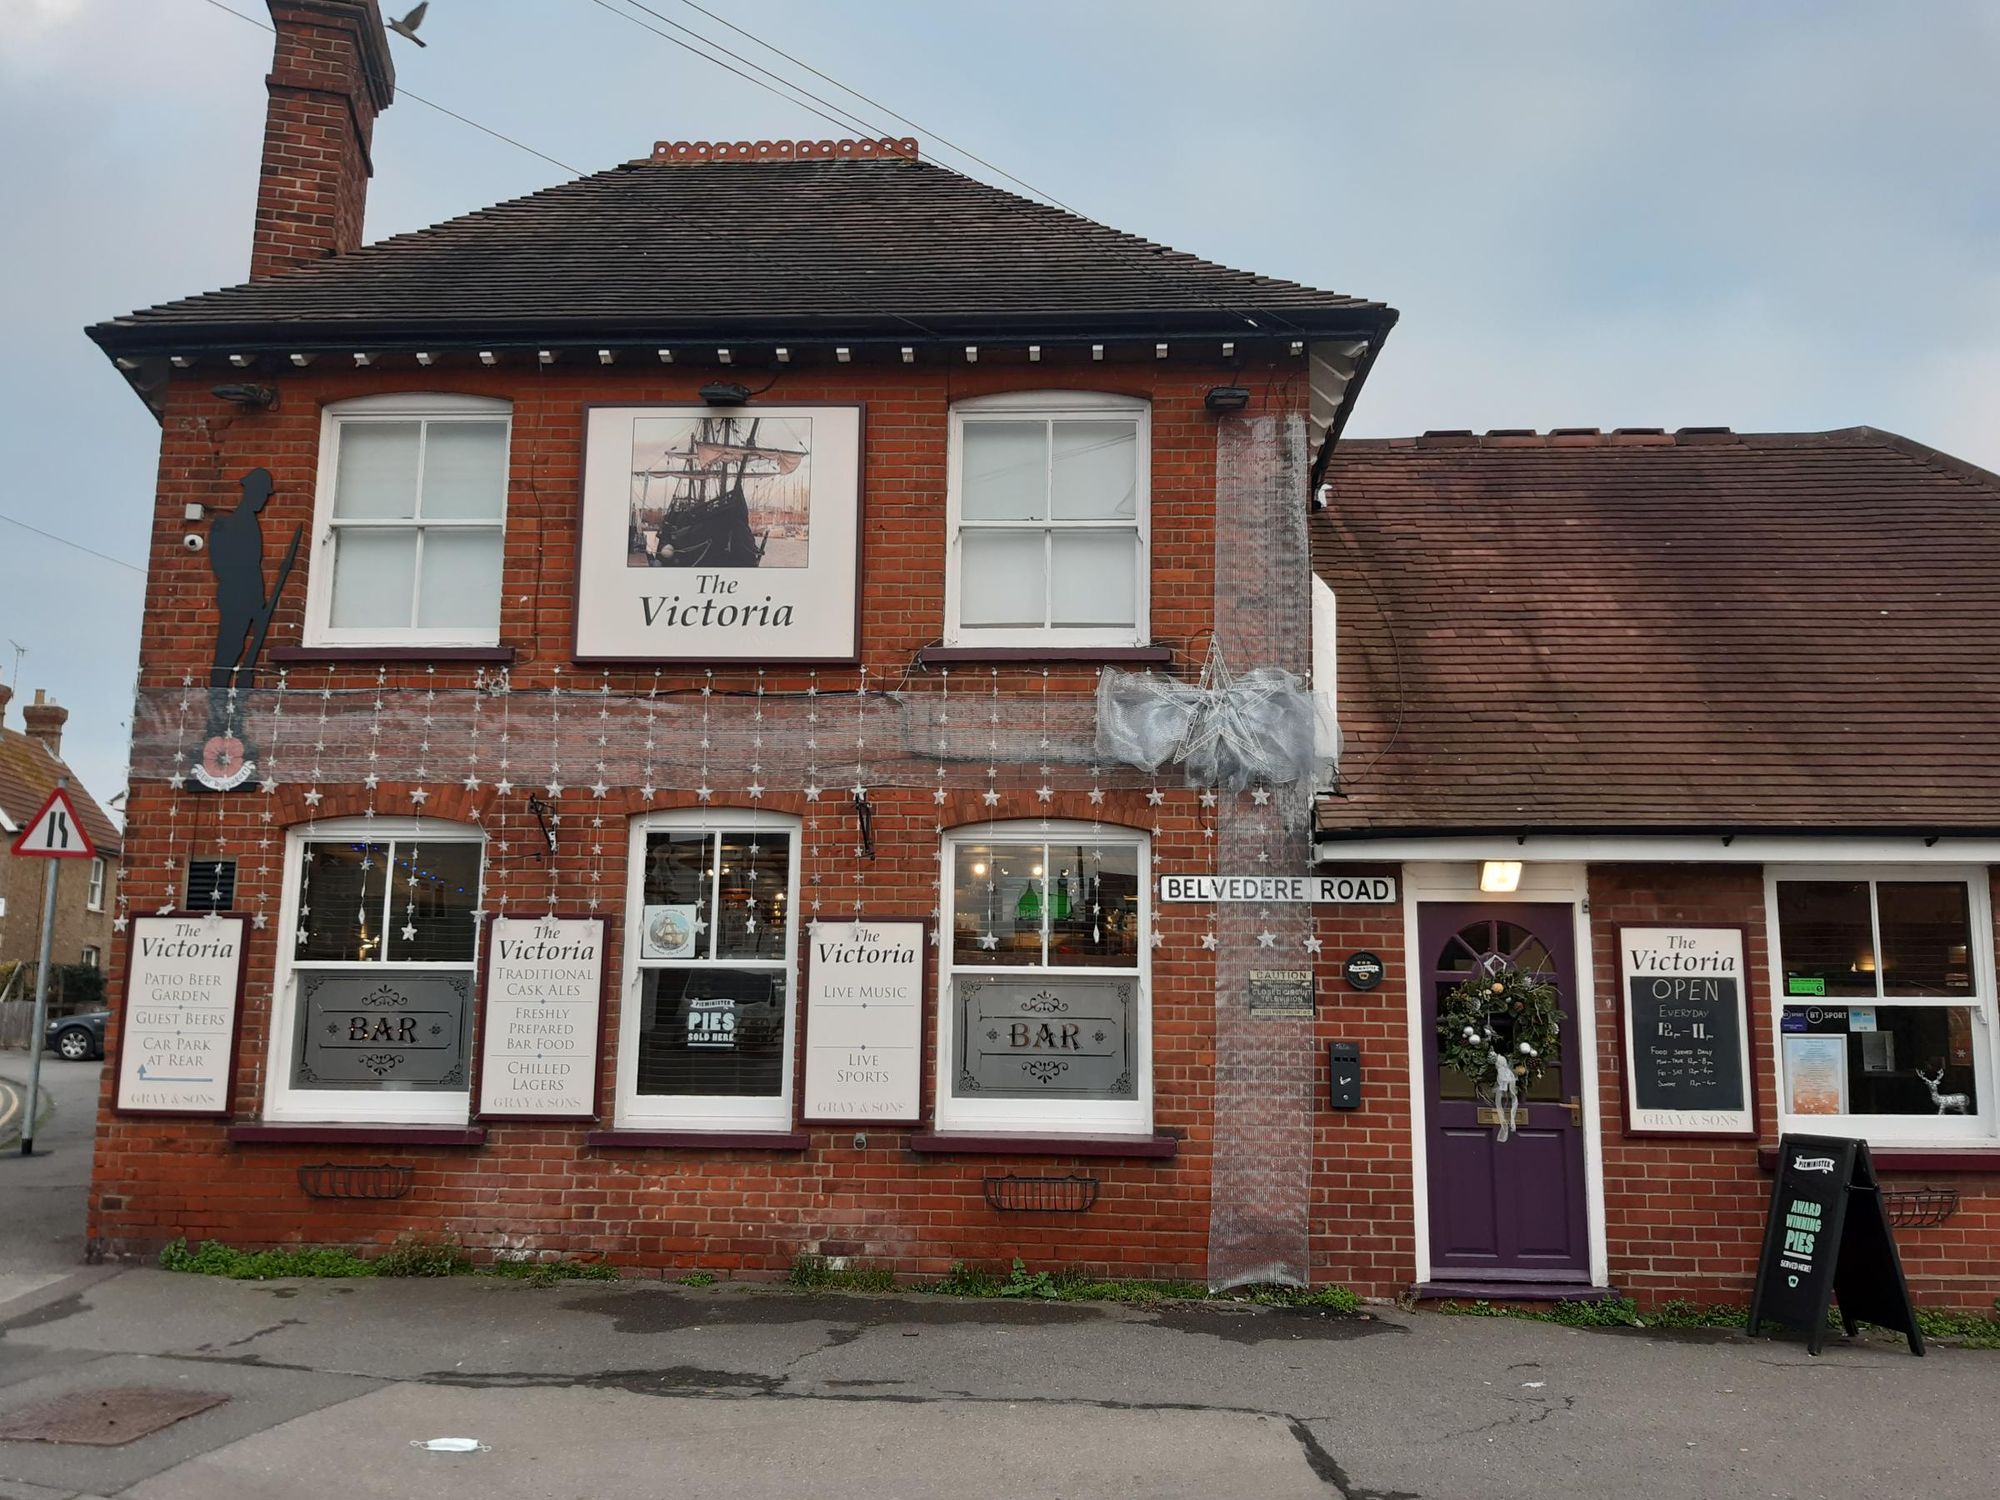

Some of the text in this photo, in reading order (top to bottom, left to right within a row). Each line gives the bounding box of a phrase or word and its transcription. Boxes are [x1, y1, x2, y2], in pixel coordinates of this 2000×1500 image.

[696, 574, 738, 594] The
[640, 596, 794, 627] Victoria
[1168, 878, 1389, 901] BELVEDERE ROAD
[175, 924, 200, 937] The
[534, 926, 560, 939] The
[854, 929, 880, 942] The
[141, 937, 233, 958] Victoria
[1667, 935, 1696, 949] The
[499, 940, 595, 961] Victoria
[818, 943, 915, 964] Victoria
[1630, 950, 1735, 971] Victoria
[144, 972, 222, 986] PATIO BEER
[496, 967, 594, 980] TRADITIONAL
[1256, 971, 1307, 979] CAUTION
[151, 989, 210, 1001] GARDEN
[507, 983, 580, 996] CASK ALES
[824, 985, 908, 999] LIVE MUSIC
[1652, 979, 1719, 1001] OPEN
[516, 1007, 570, 1019] FRESHLY
[1659, 1004, 1710, 1018] EVERYDAY
[1809, 1011, 1820, 1019] BT
[136, 1011, 225, 1026] GUEST BEERS
[688, 1012, 735, 1030] PIES
[349, 1016, 417, 1043] BAR
[509, 1023, 574, 1035] PREPARED
[688, 1033, 734, 1041] SOLD HERE
[1009, 1023, 1080, 1050] BAR
[143, 1037, 211, 1051] CAR PARK
[507, 1038, 574, 1050] BAR FOOD
[146, 1054, 204, 1067] AT REAR
[849, 1053, 879, 1066] LIVE
[507, 1061, 570, 1075] CHILLED
[837, 1070, 889, 1083] SPORTS
[512, 1078, 564, 1091] LAGERS
[1643, 1113, 1739, 1127] GRAY & SONS
[1791, 1200, 1821, 1216] AWARD
[1786, 1214, 1821, 1232] WINNING
[1784, 1229, 1815, 1254] PIES
[1780, 1259, 1798, 1270] SERVED
